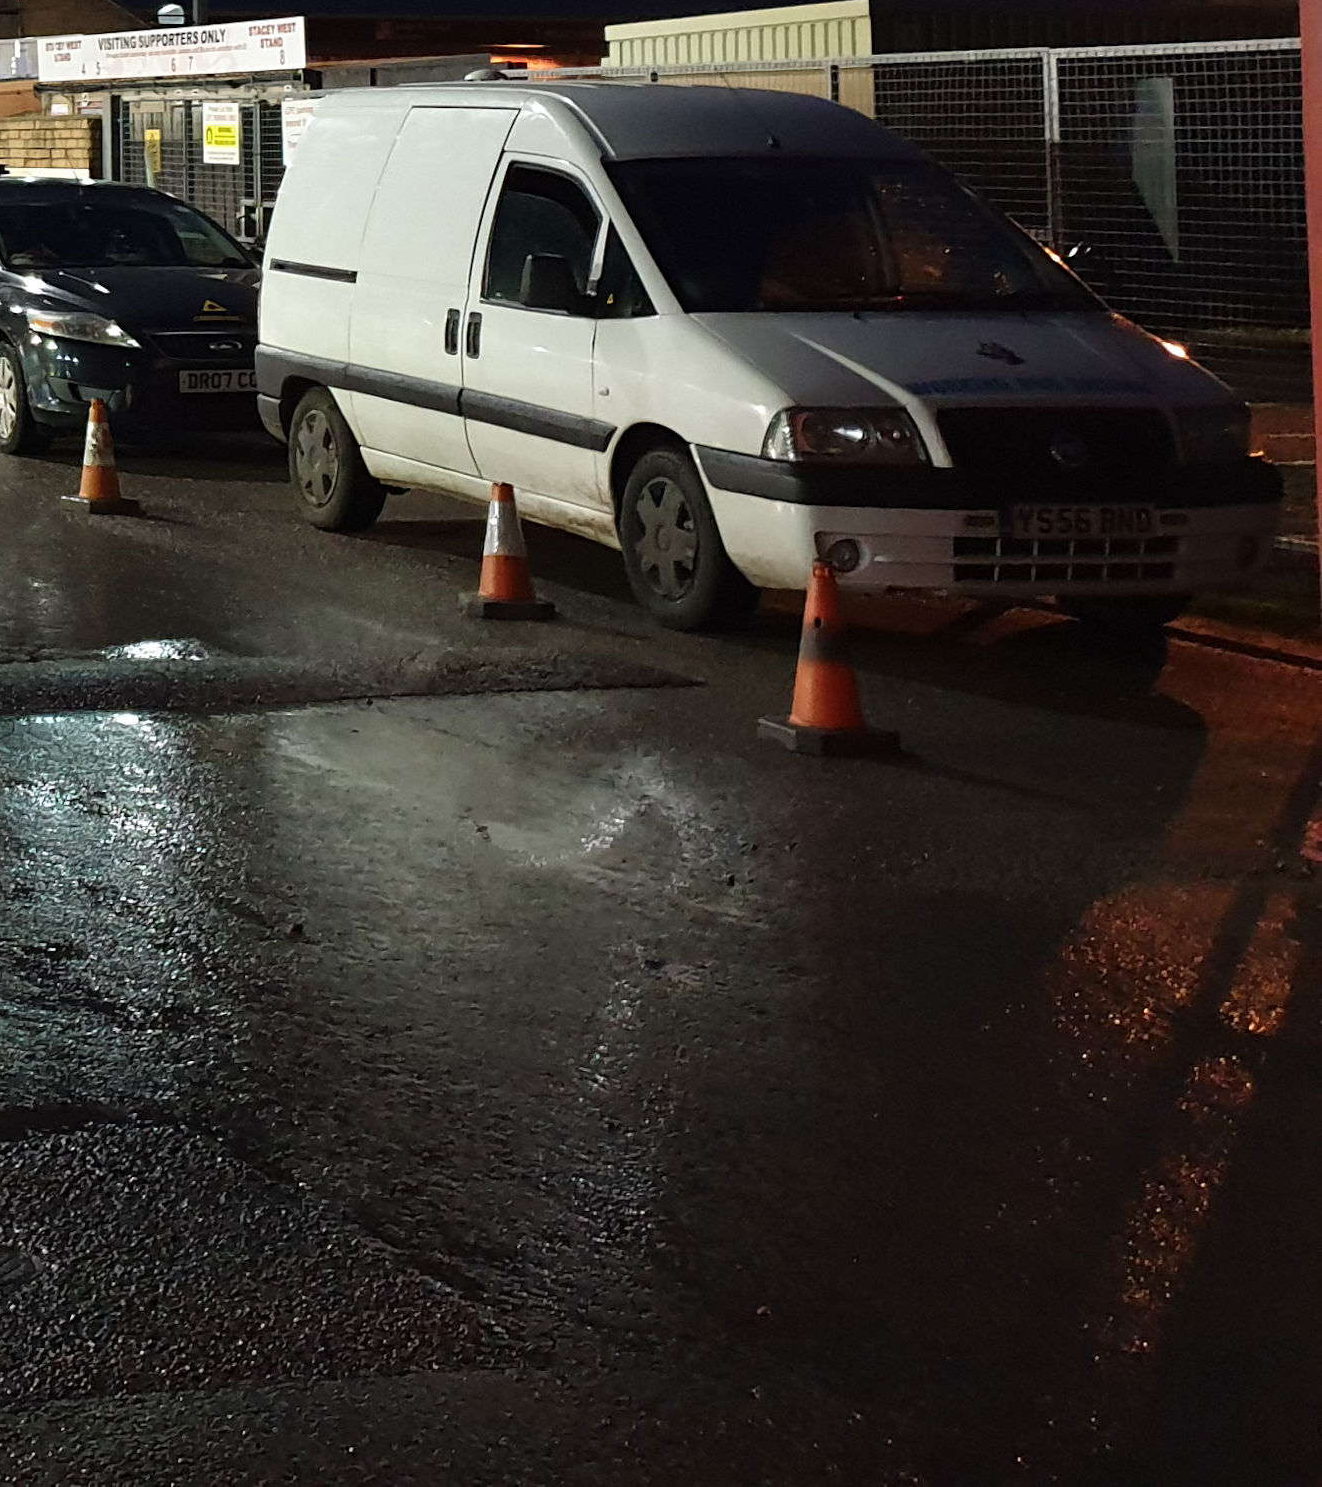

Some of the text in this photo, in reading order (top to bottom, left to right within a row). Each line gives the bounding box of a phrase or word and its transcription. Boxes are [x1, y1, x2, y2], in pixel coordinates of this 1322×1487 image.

[248, 22, 297, 37] STACEY WEST
[97, 34, 137, 52] VISITING
[138, 30, 199, 50] SUPPORTERS
[200, 28, 227, 45] ONLY
[260, 37, 284, 49] STAND
[171, 57, 177, 73] 6
[279, 50, 286, 65] 8
[95, 62, 102, 75] 5
[188, 372, 232, 389] DR07
